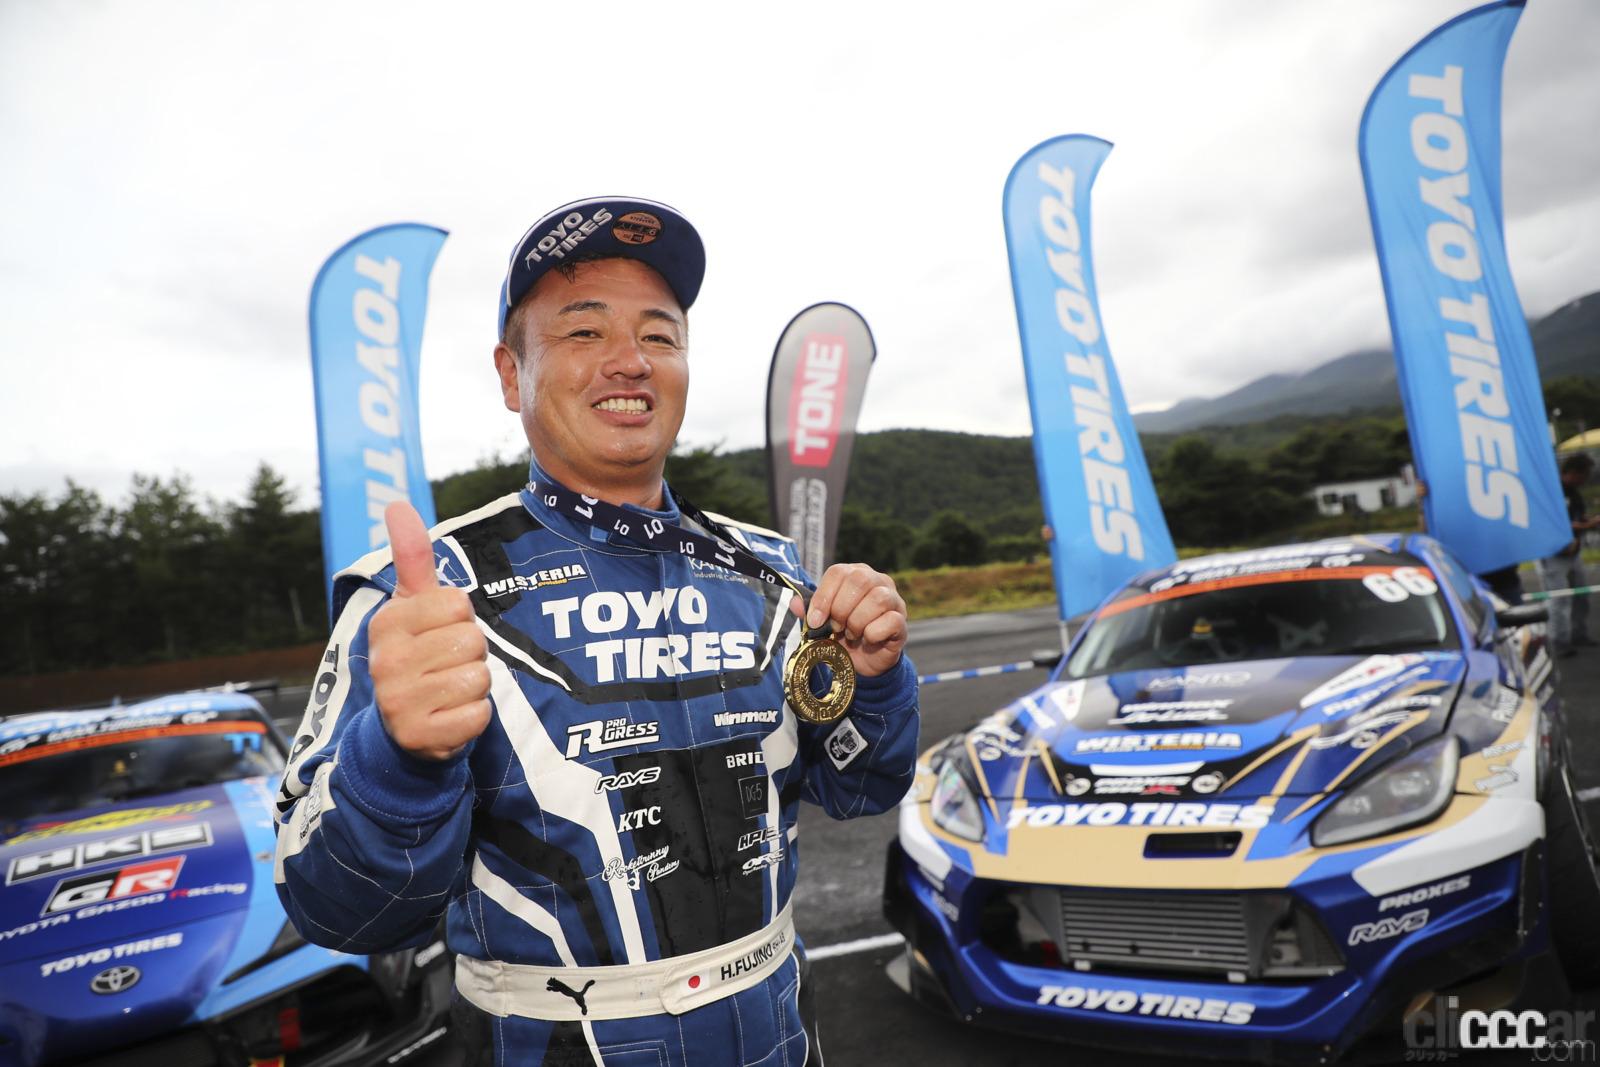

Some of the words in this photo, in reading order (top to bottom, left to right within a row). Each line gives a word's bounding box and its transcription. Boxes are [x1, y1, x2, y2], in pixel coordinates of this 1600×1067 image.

[1408, 64, 1482, 281] TOYO
[525, 211, 583, 266] TOYO
[548, 208, 613, 260] TIRES
[1037, 161, 1101, 346] TOYO
[354, 254, 402, 438] TOYO
[794, 340, 843, 455] TONE
[1439, 292, 1530, 529] TIRES
[1064, 353, 1144, 561] TIRES
[613, 519, 630, 536] D1
[643, 518, 664, 540] D1
[680, 541, 695, 554] D1
[483, 564, 587, 595] WISTERIA
[1362, 567, 1438, 602] 66
[541, 585, 708, 639] TOYO
[585, 631, 756, 683] TIRES
[604, 722, 659, 741] GRESS
[606, 718, 627, 729] PRO
[713, 709, 779, 727] Winmax
[594, 766, 661, 794] RAYS
[617, 806, 662, 834] KTC
[1006, 803, 1127, 828] TOYO
[1130, 803, 1274, 829] TIRES
[14, 829, 207, 878] HKS
[48, 868, 175, 913] GR
[1378, 875, 1472, 912] PROXES
[1348, 908, 1430, 946] RAYS
[40, 949, 112, 978] TOYO
[112, 932, 184, 958] TIRES
[720, 943, 773, 980] H.FUJINO
[1036, 984, 1138, 1013] TOYO
[1138, 992, 1256, 1025] TIRES
